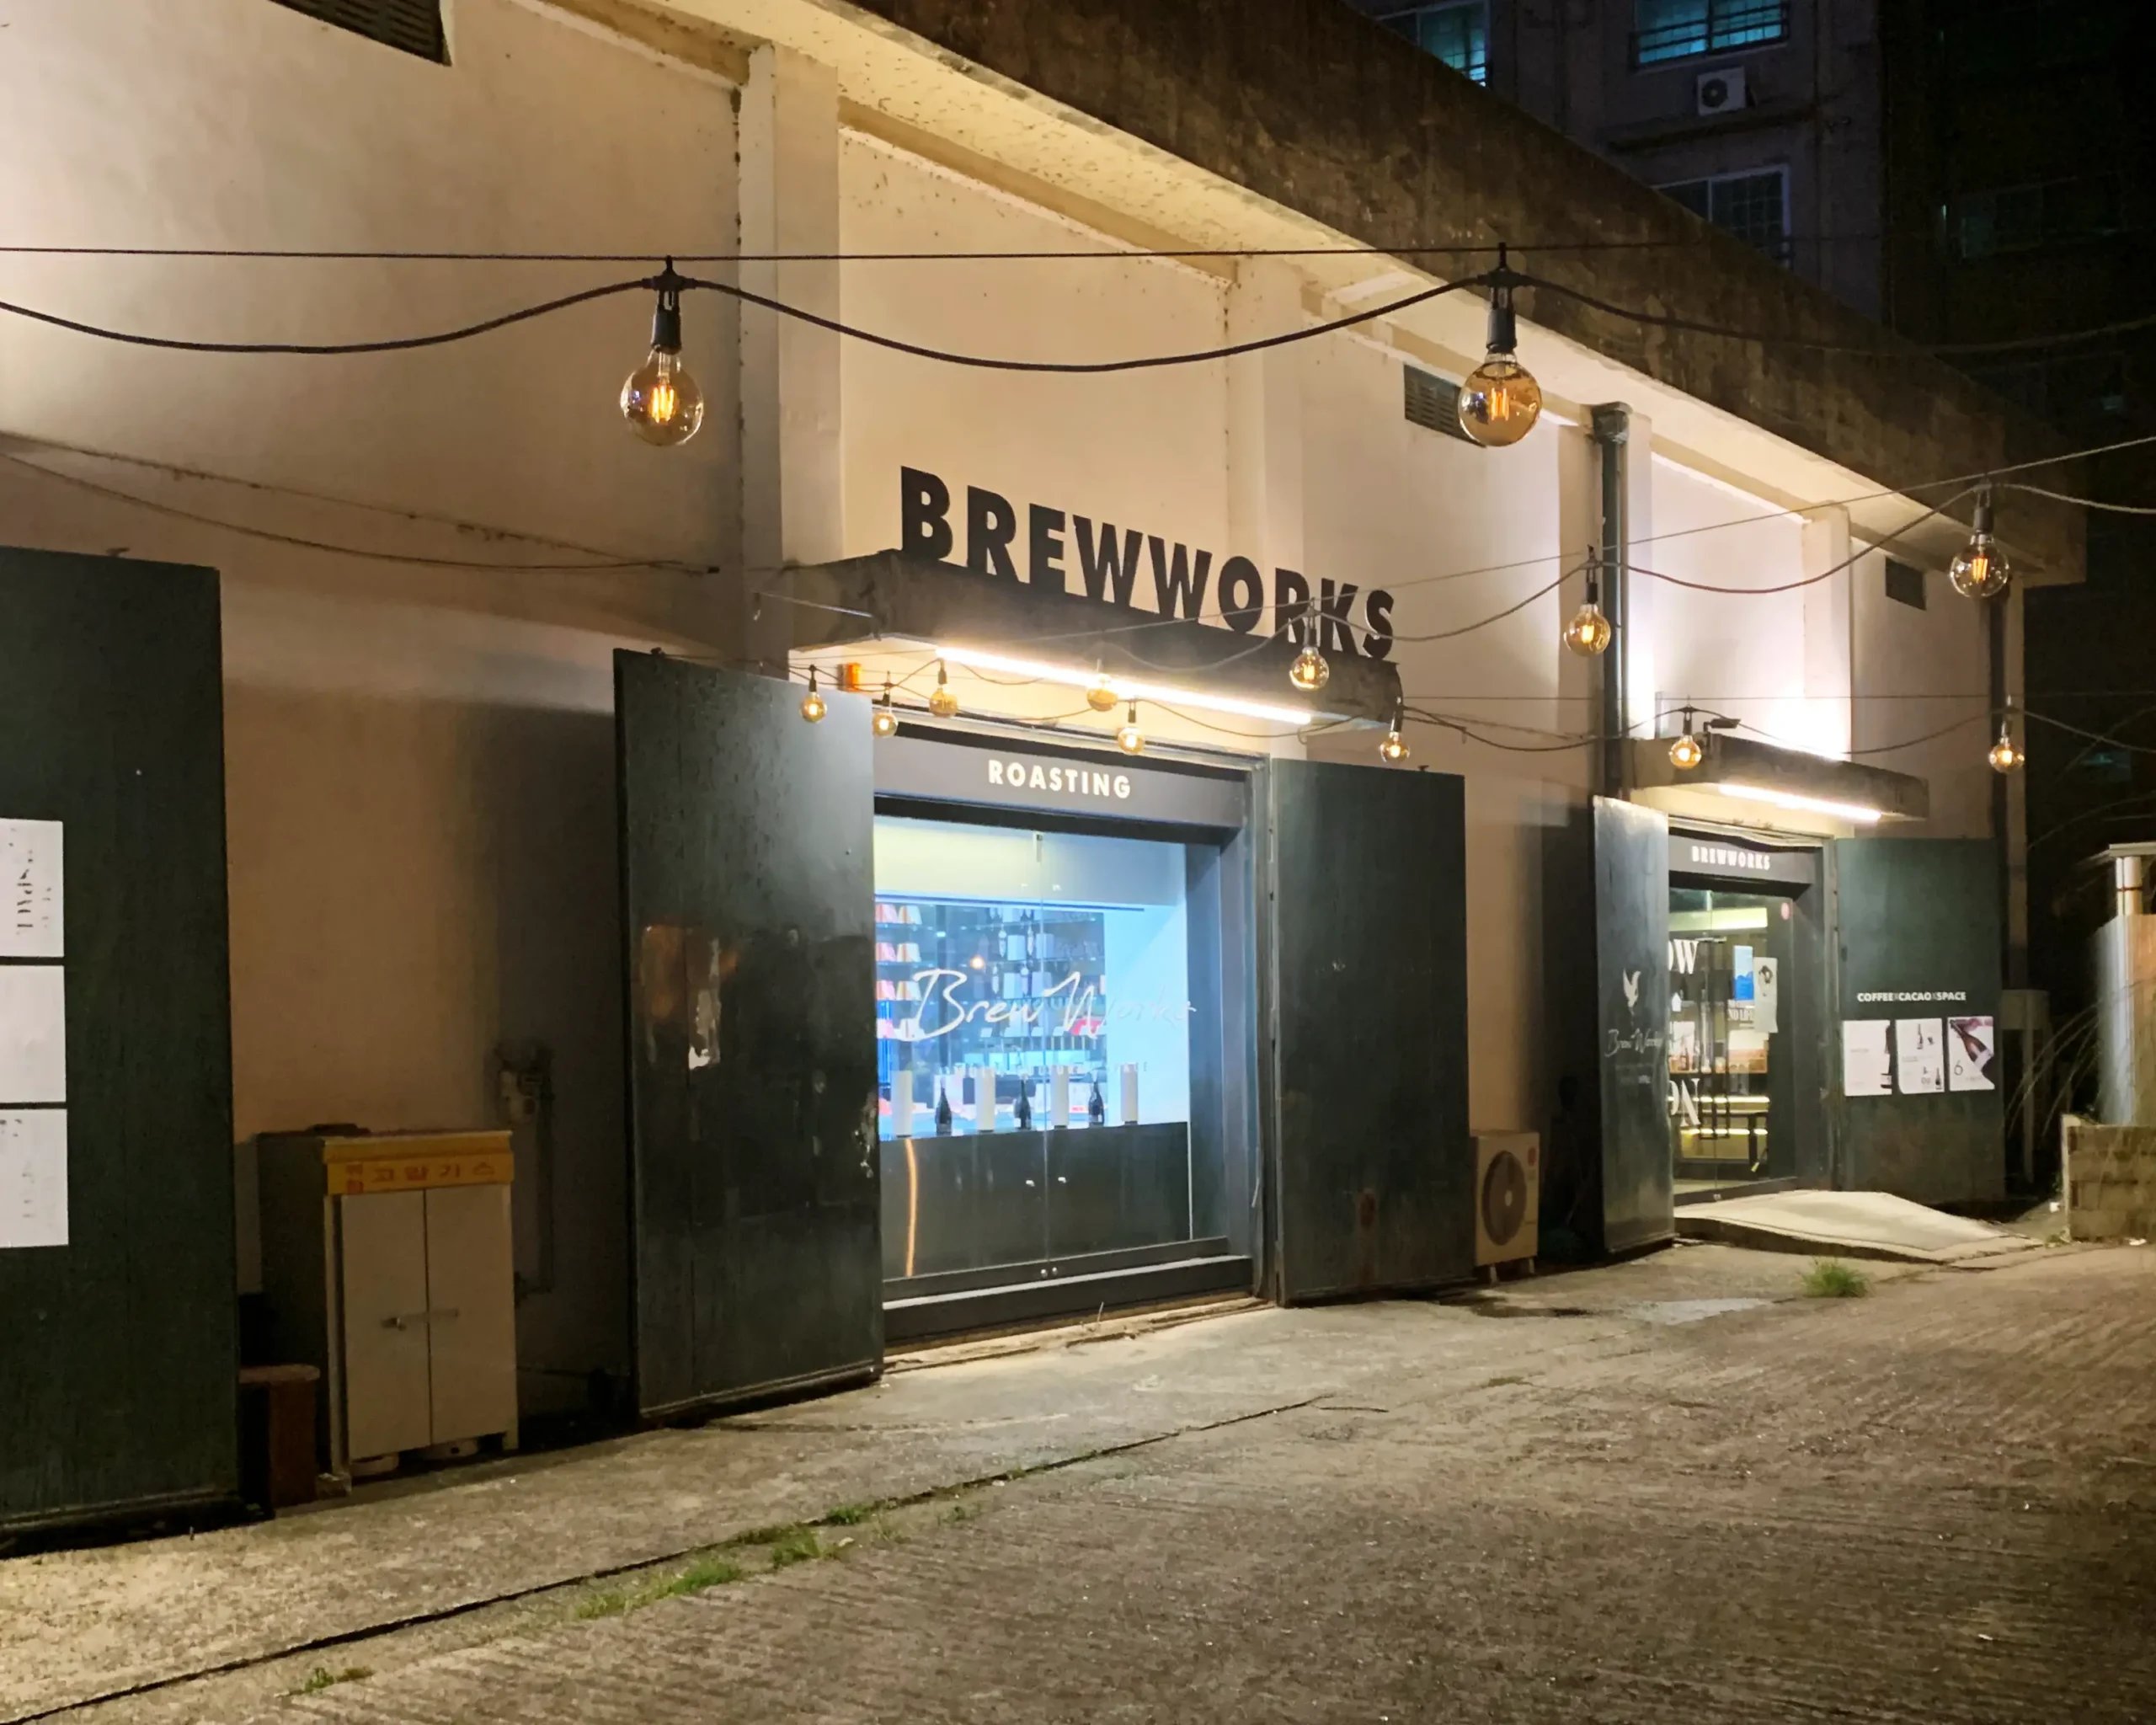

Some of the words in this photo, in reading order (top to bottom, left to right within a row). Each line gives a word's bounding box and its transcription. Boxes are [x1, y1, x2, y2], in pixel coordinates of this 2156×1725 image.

[900, 465, 1395, 660] BREWWORKS
[988, 759, 1132, 799] ROASTING
[1691, 846, 1770, 871] BREWWORKS
[1857, 992, 1894, 1002] COFFEE
[1898, 992, 1933, 1001] CACAO
[1936, 991, 1967, 1001] SPACE
